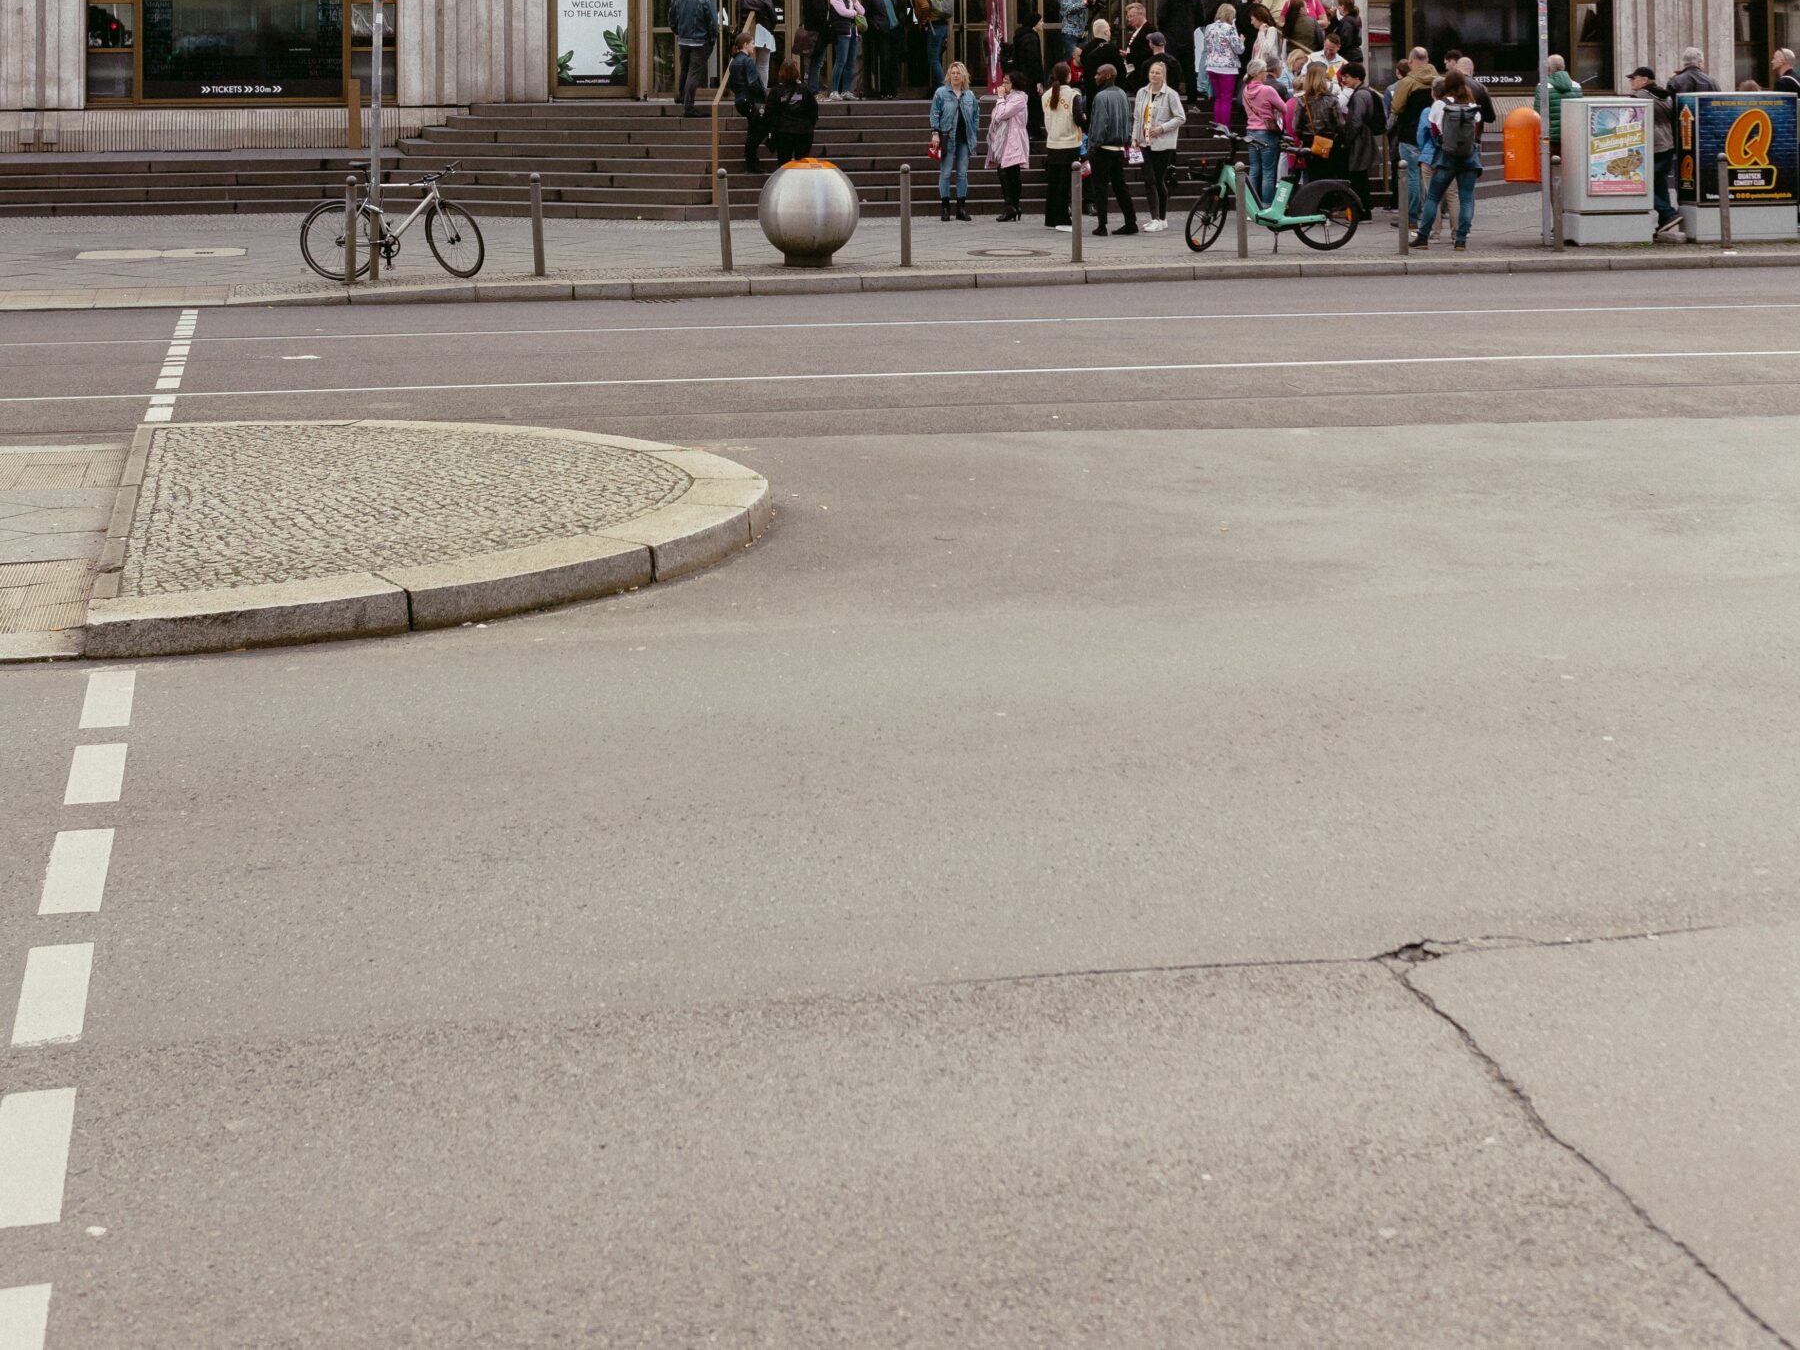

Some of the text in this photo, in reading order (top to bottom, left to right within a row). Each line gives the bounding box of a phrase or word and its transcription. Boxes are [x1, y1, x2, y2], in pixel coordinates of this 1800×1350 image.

[211, 85, 272, 93] TICKETS 30m
[1725, 108, 1773, 167] Q
